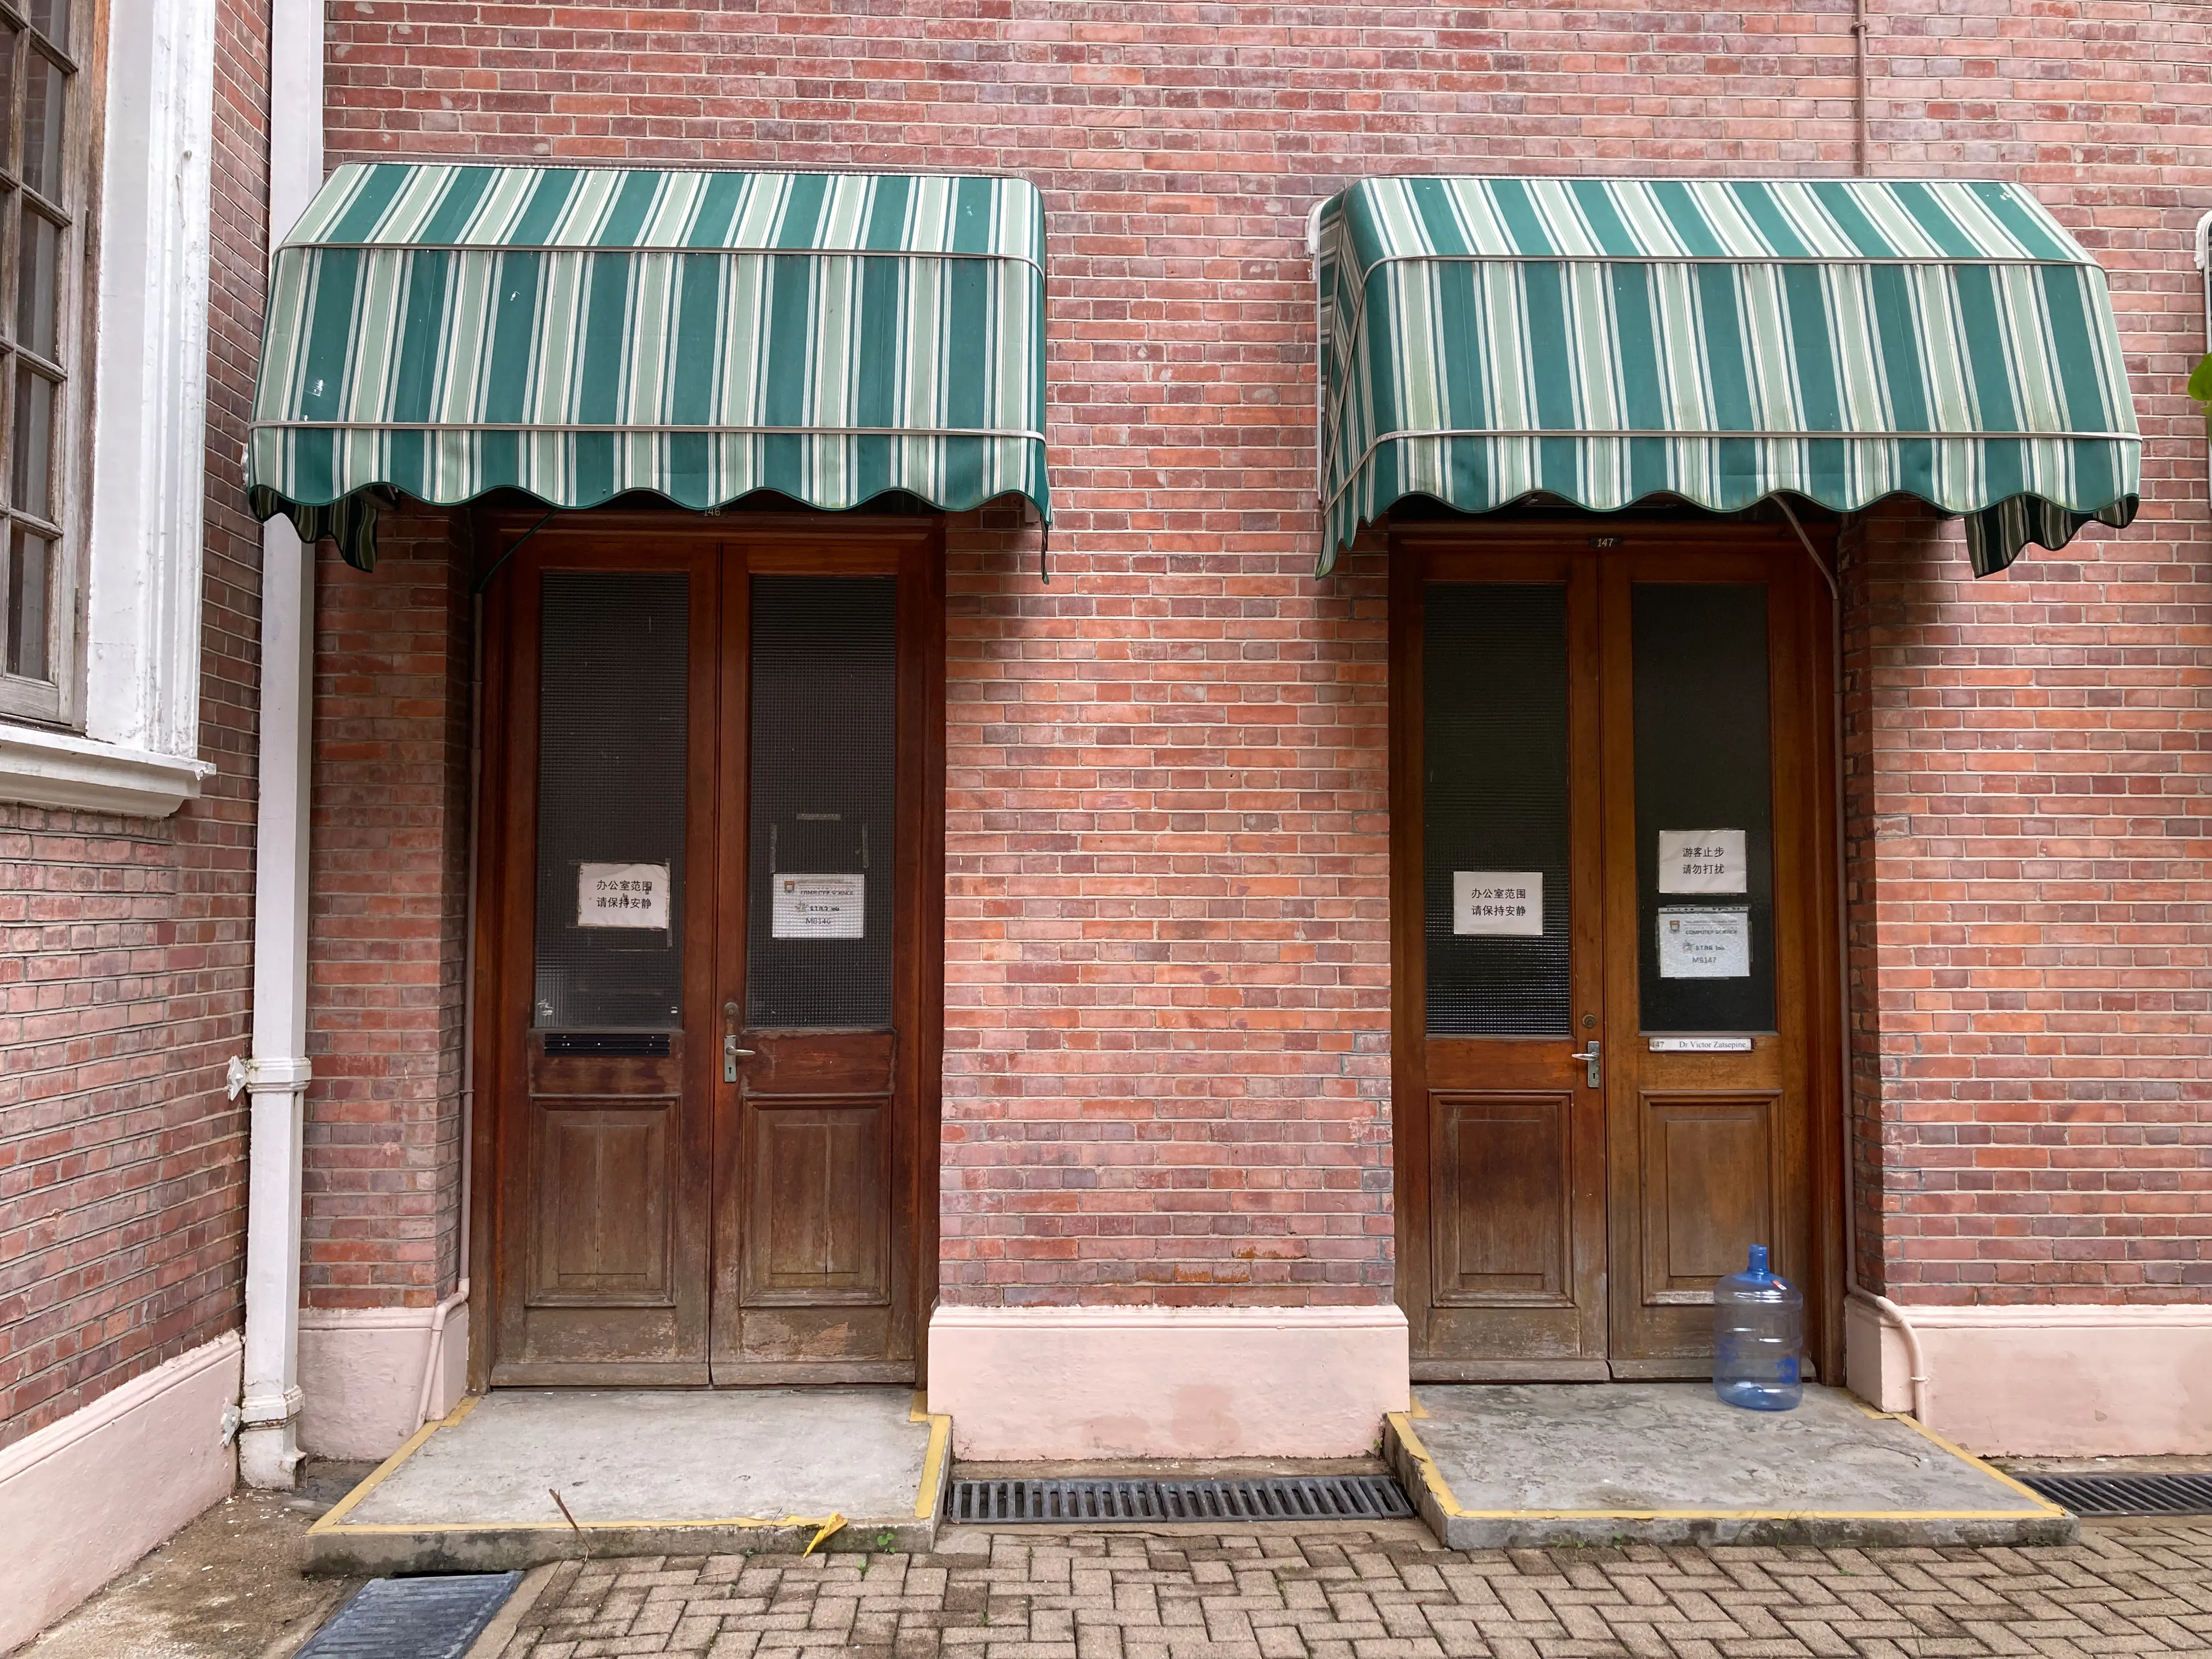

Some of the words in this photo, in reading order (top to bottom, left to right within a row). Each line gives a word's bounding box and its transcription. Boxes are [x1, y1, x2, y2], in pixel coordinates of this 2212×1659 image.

[704, 507, 721, 516] 146
[1598, 538, 1613, 547] 147
[1682, 847, 1724, 857] 游客止步
[1683, 864, 1724, 874] 请勿打扰
[596, 879, 652, 891] 办公室范围
[1471, 888, 1526, 899] 办公室范围
[596, 897, 652, 909] 请保持安静
[1471, 905, 1526, 916] 请保持安静
[1714, 1041, 1746, 1049] Zatsepine
